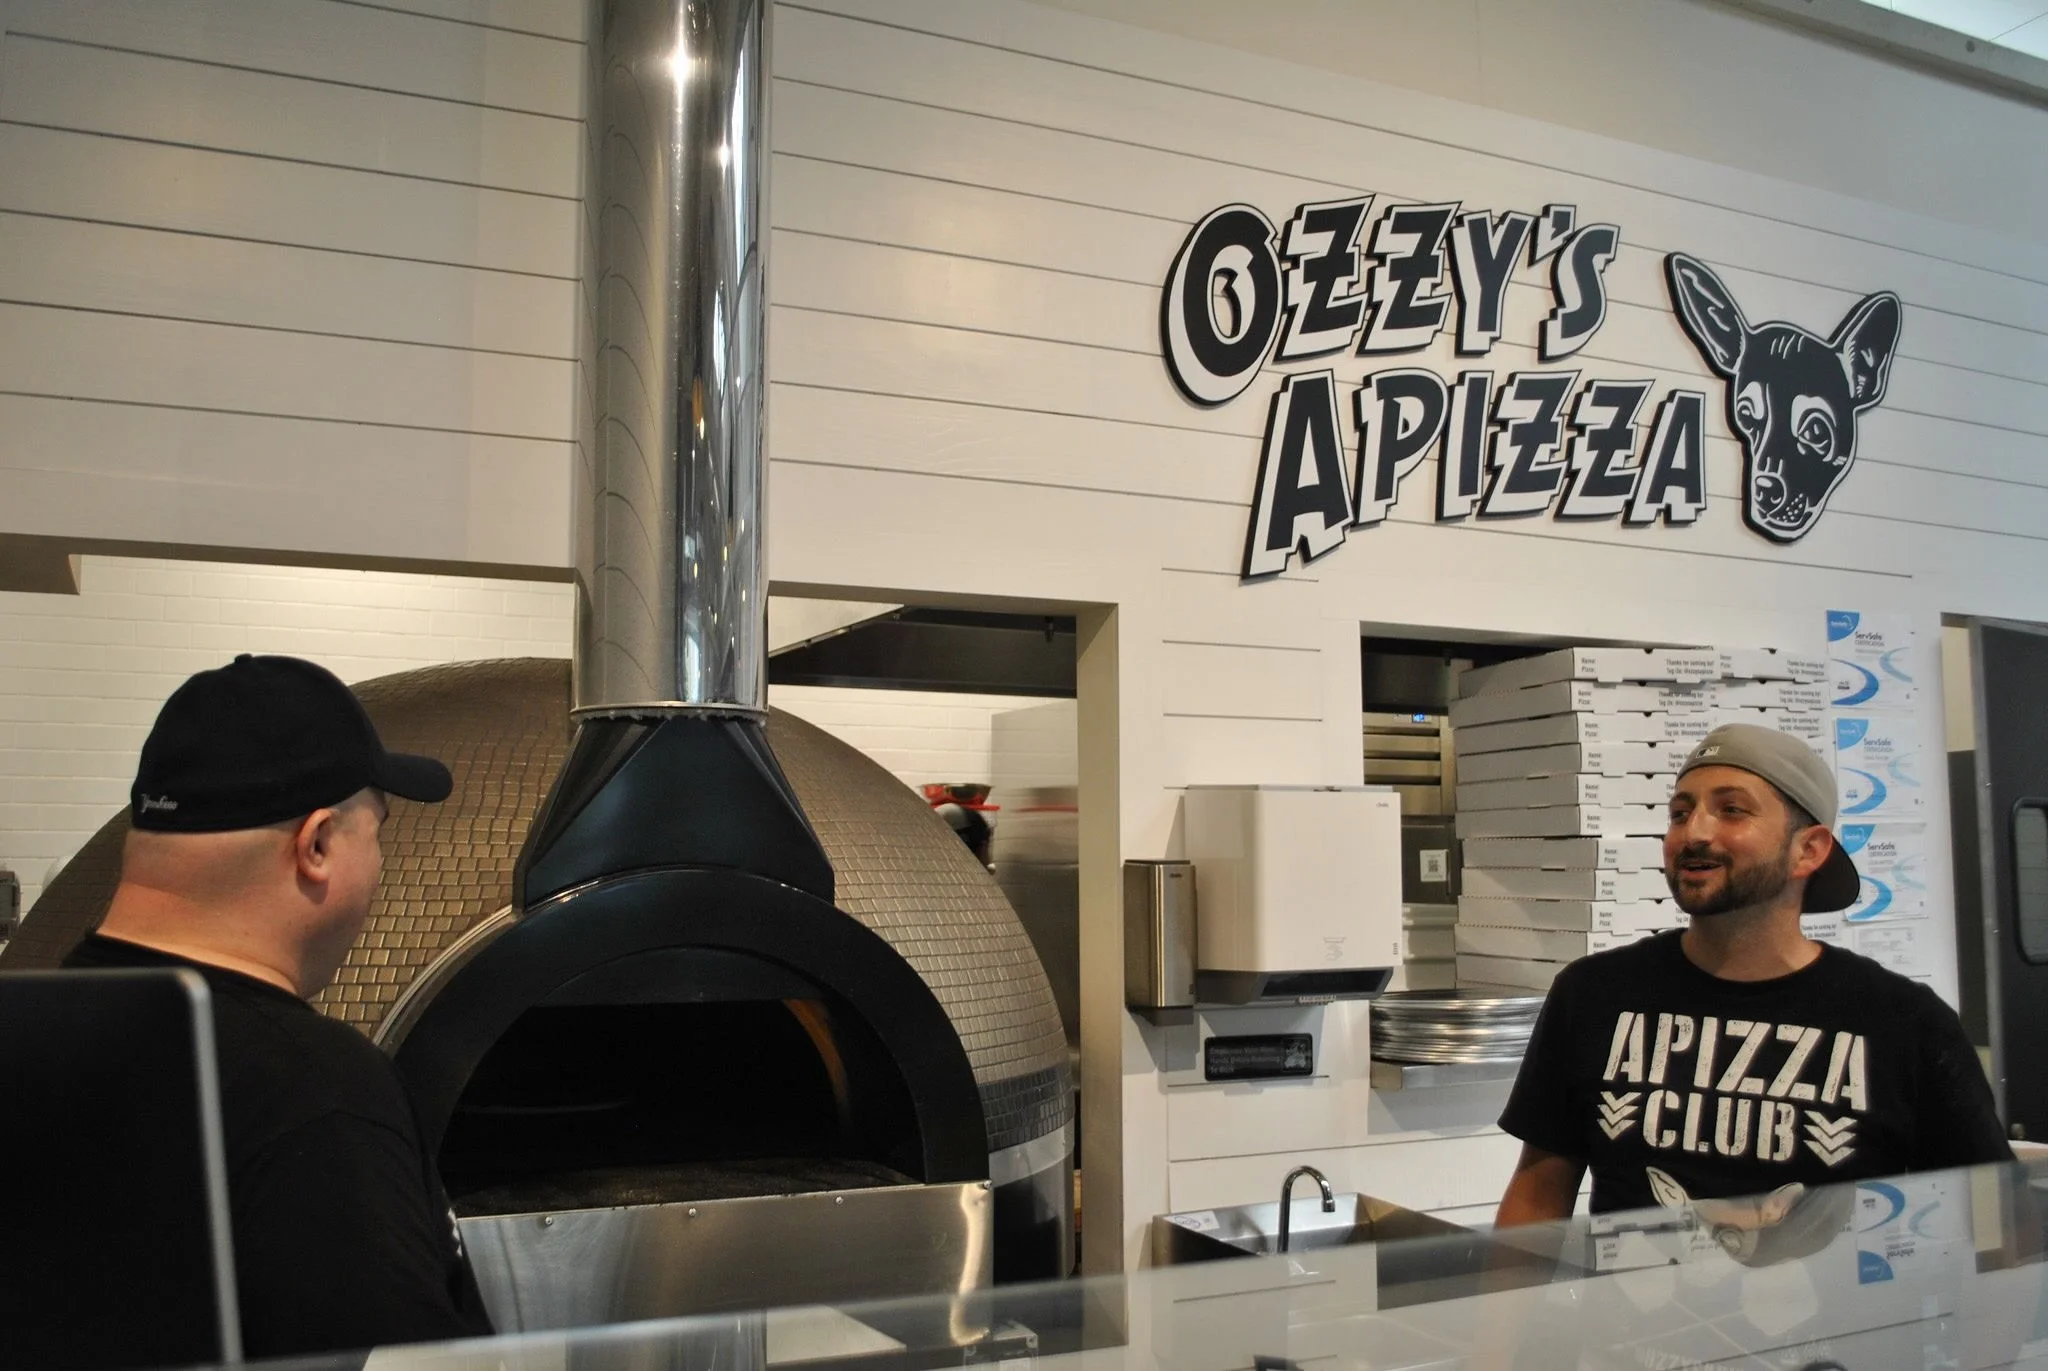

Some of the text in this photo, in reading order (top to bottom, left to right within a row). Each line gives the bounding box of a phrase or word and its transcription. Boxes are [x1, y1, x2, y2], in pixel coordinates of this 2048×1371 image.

[1161, 194, 1620, 406] OZZY'S
[1242, 368, 1706, 580] APIZZA
[1603, 1011, 1867, 1111] APIZZA
[1643, 1089, 1796, 1162] CLUB
